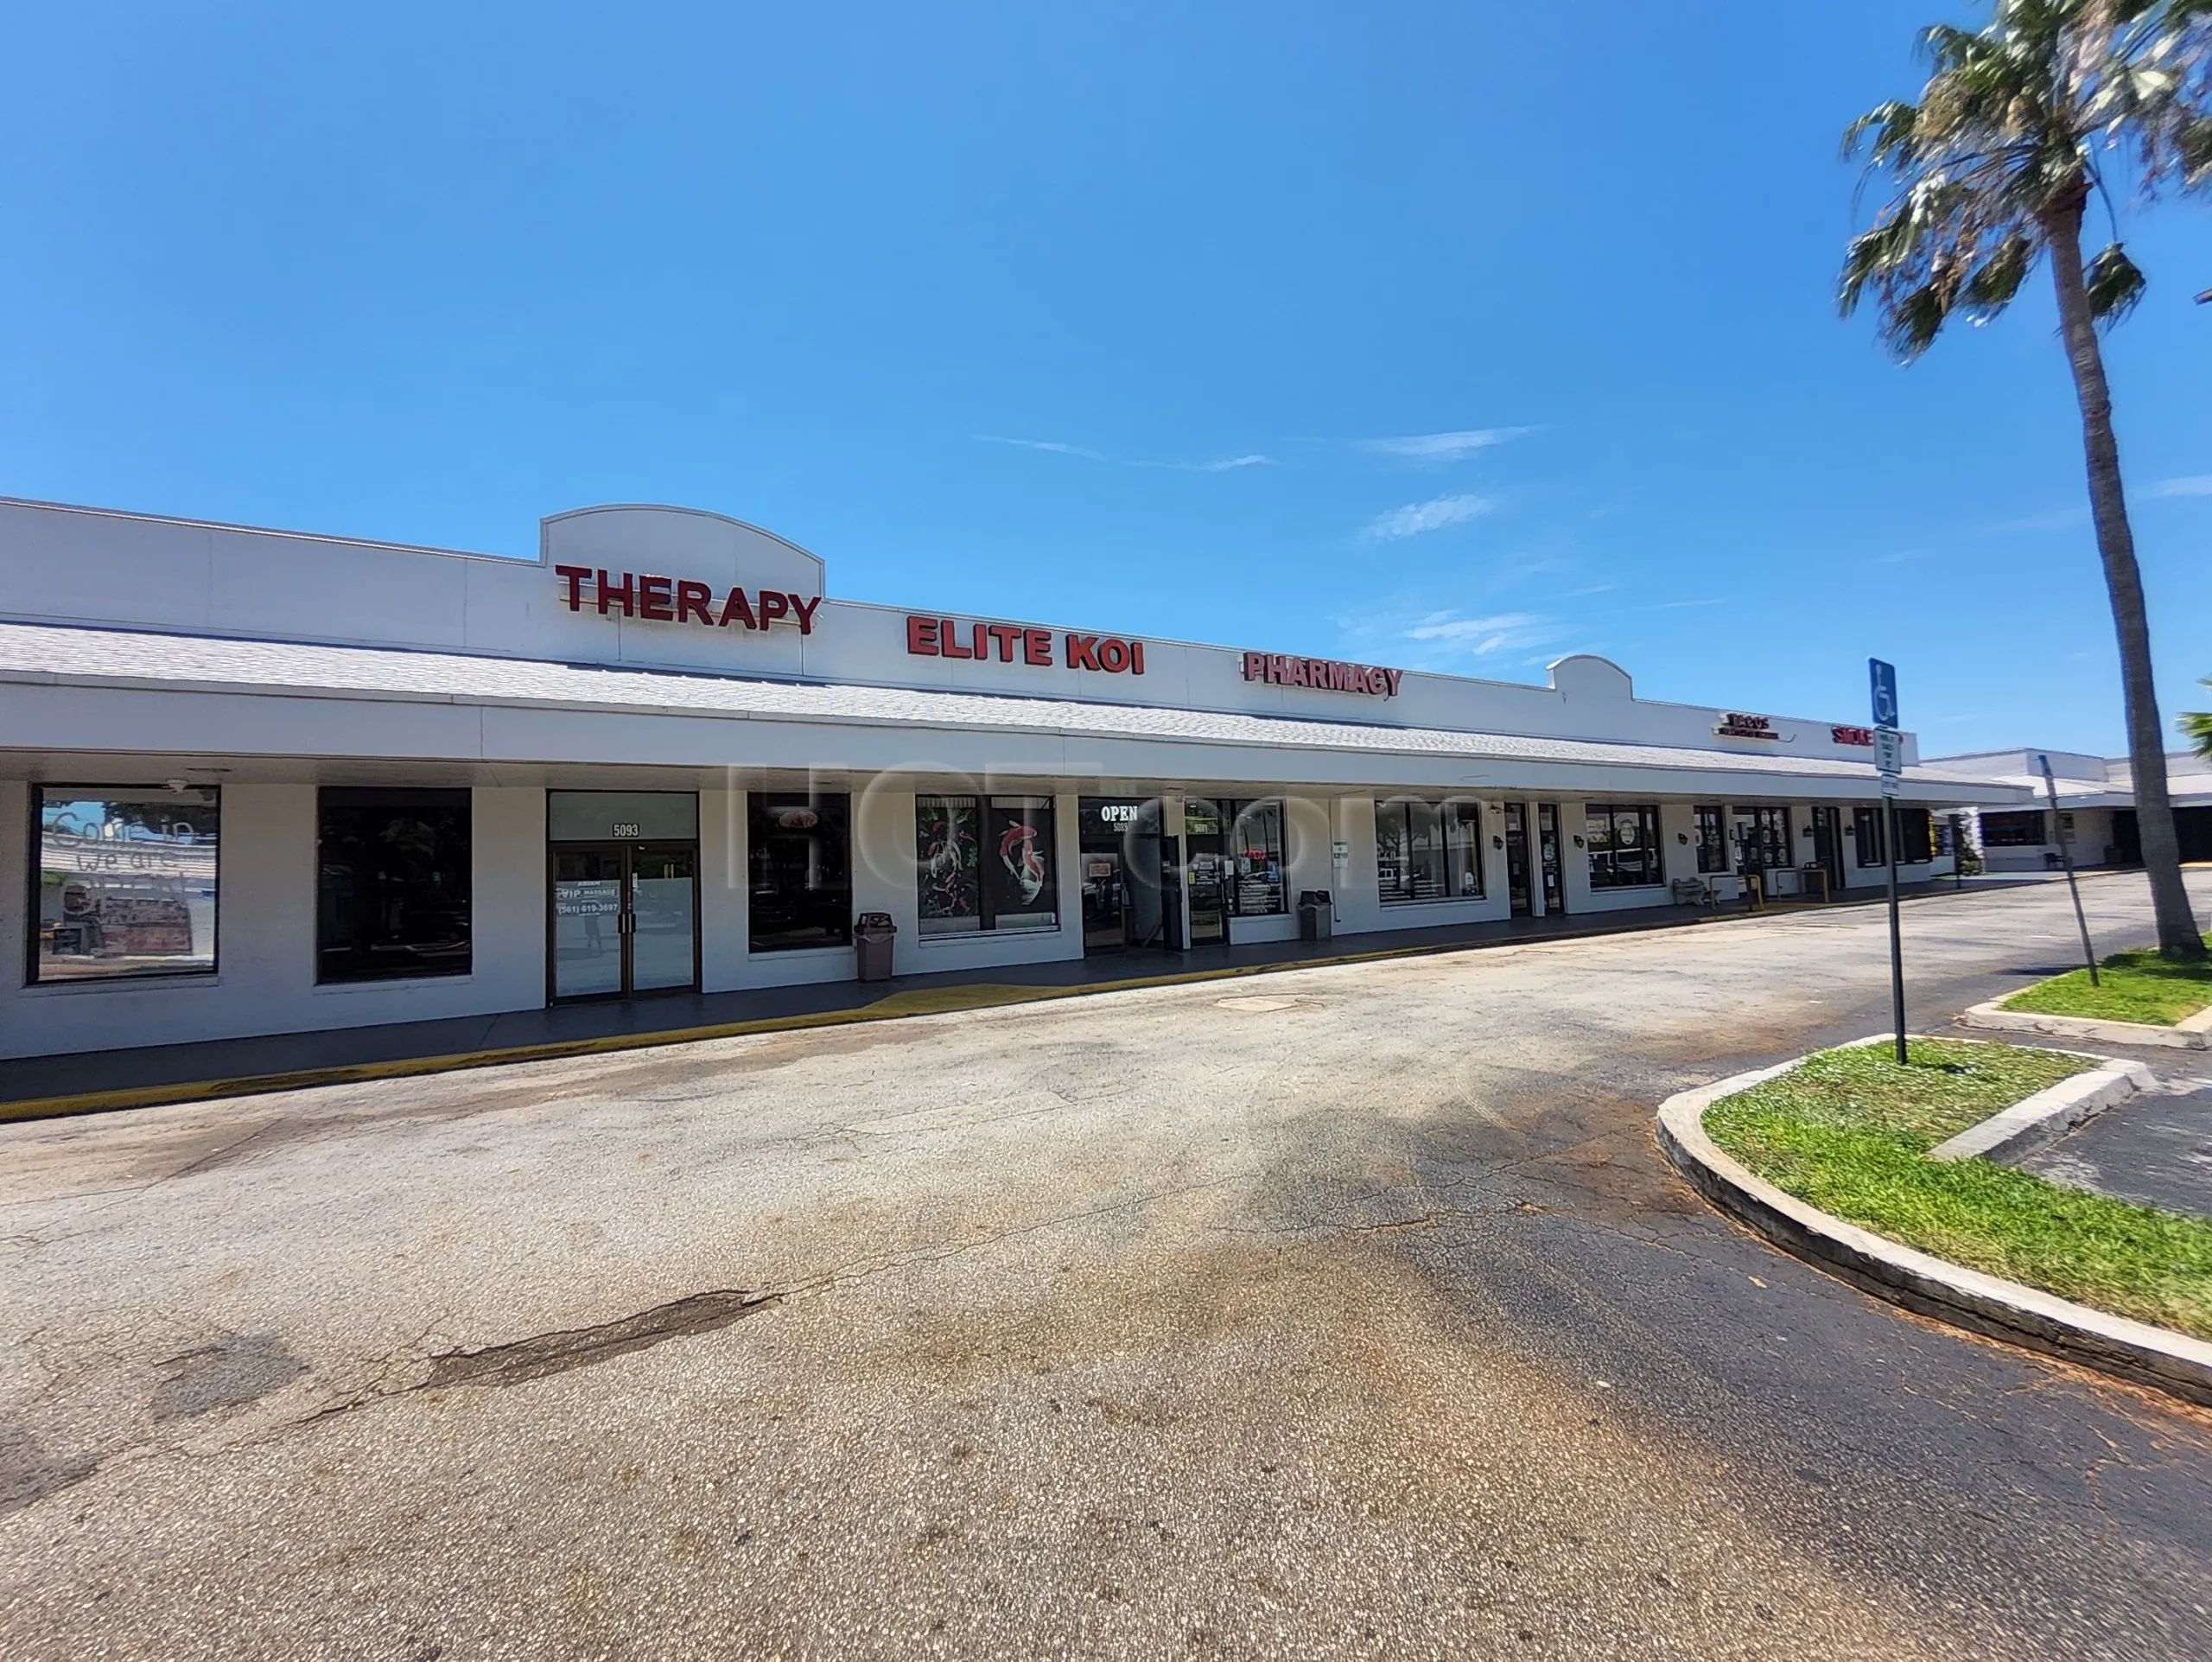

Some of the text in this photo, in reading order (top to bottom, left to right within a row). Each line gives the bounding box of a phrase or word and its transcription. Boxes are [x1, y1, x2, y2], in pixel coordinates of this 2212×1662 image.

[556, 564, 822, 635] THERAPY
[907, 615, 1145, 675] ELITE KOI
[1243, 652, 1403, 696] PHARMACY
[613, 824, 639, 837] 5093
[1101, 806, 1138, 822] OPEN
